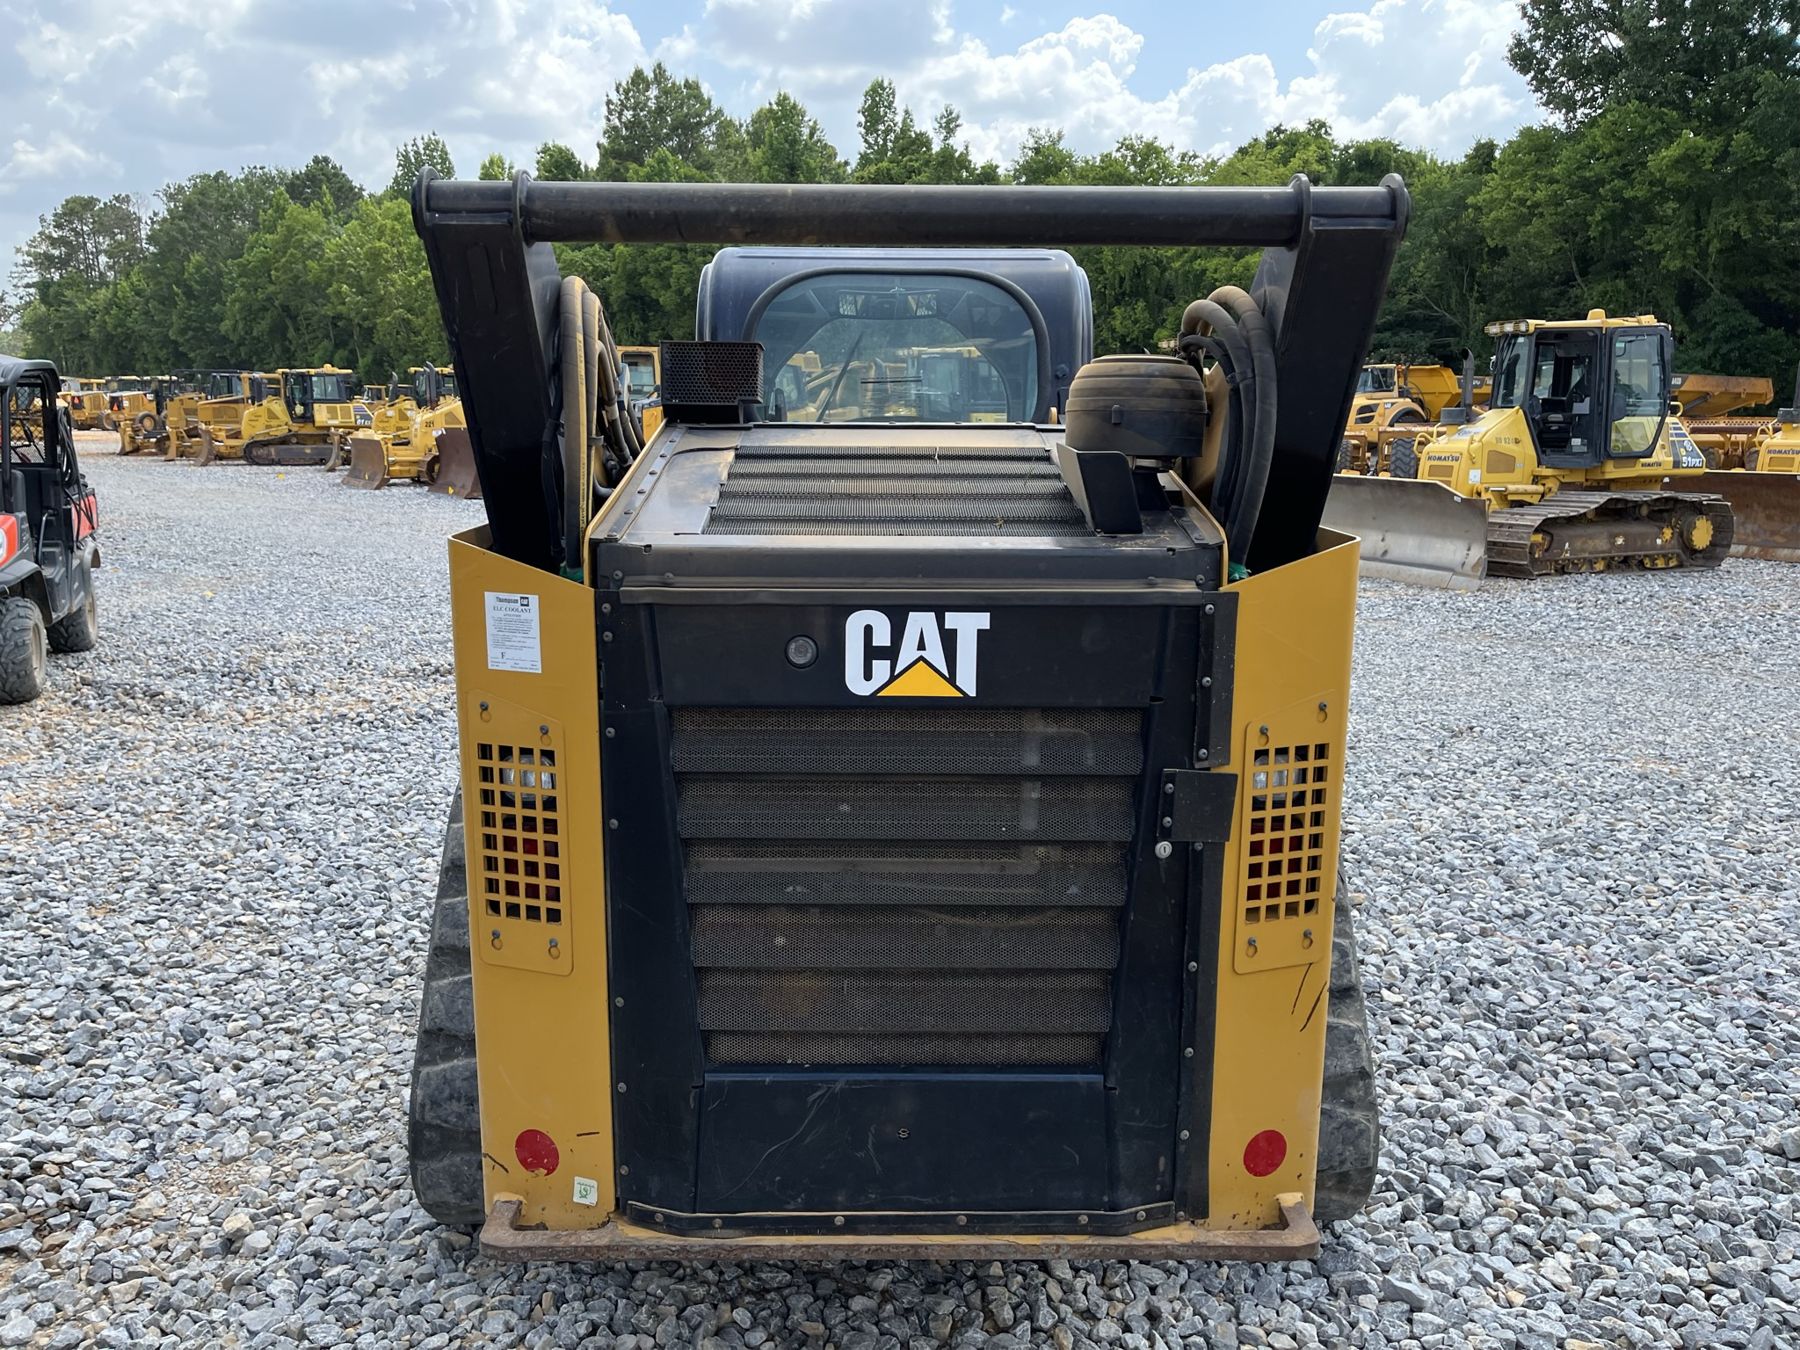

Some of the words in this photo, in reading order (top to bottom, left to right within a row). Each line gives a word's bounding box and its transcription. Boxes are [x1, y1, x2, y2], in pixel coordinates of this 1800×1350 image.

[1427, 454, 1460, 462] KOMATSU
[496, 596, 519, 604] Thompson
[845, 609, 990, 697] CAT
